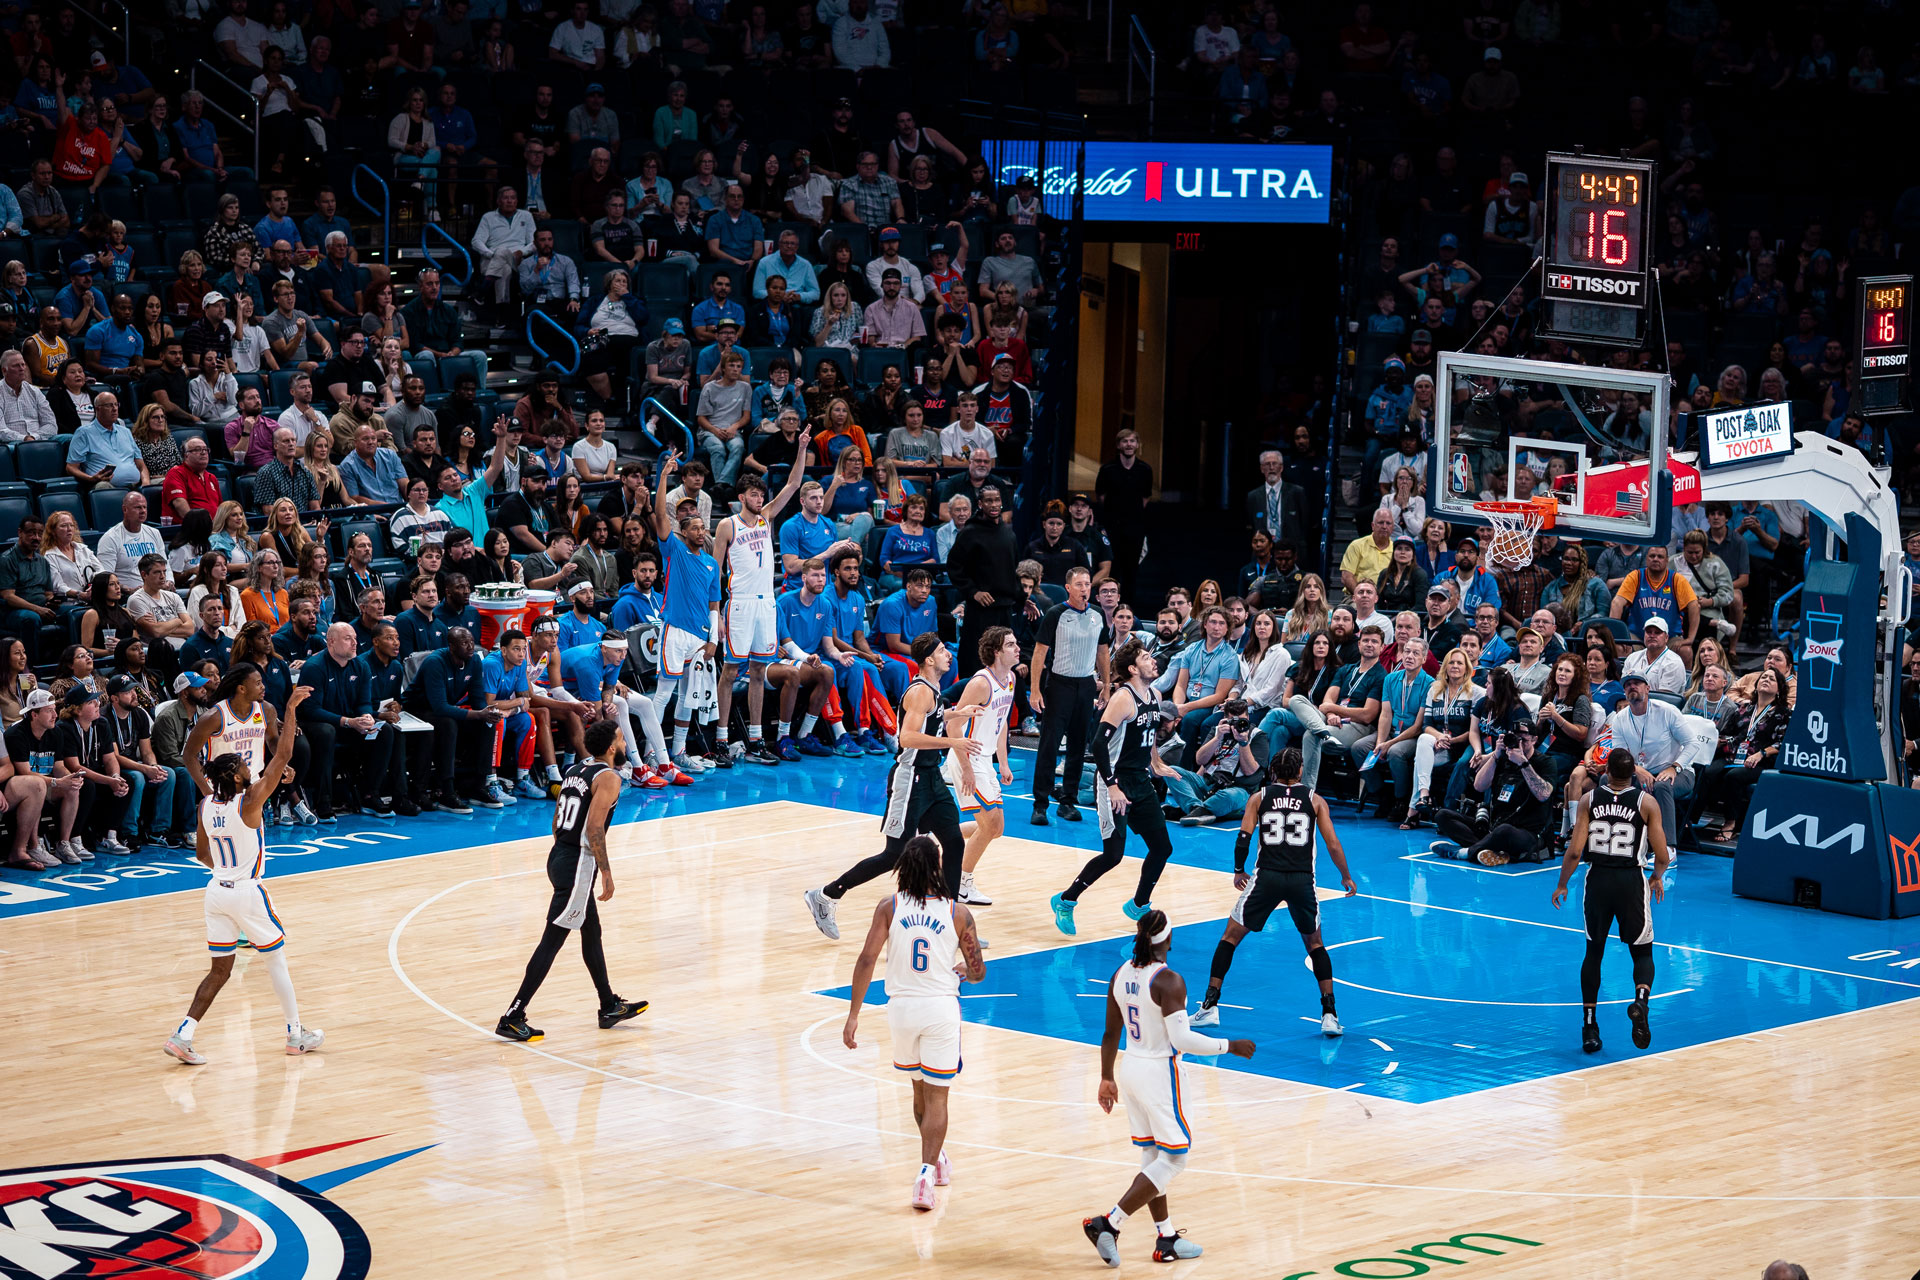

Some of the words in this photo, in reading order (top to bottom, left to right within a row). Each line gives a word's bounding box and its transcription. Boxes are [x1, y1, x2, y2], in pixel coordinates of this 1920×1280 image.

[1580, 173, 1638, 204] 4:47
[1176, 232, 1201, 250] EXIT
[1587, 210, 1628, 264] 16
[1571, 275, 1640, 296] TISSOT
[1876, 288, 1903, 308] 4:47
[1880, 313, 1895, 342] 16
[1875, 354, 1908, 368] TISSOT
[924, 399, 946, 408] OKC
[985, 407, 1011, 423] OKC
[1716, 415, 1742, 441] POST
[1759, 408, 1782, 434] OAK
[1726, 438, 1773, 459] TOYOTA
[123, 542, 155, 558] THUNDER
[749, 541, 765, 551] CITY
[755, 552, 763, 568] 7
[1638, 596, 1672, 611] THUNDER
[1807, 644, 1837, 656] SONIC
[997, 705, 1009, 717] CITY
[1432, 706, 1465, 716] THUDER
[223, 727, 265, 743] OKLAHOMA
[1140, 728, 1156, 747] 16
[235, 739, 253, 752] CITY
[1784, 743, 1847, 774] Health
[556, 794, 582, 831] 30
[1272, 797, 1303, 810] JONES
[212, 815, 226, 829] JOE
[1593, 804, 1636, 822] BRANHAM
[1260, 811, 1311, 847] 33
[1588, 820, 1635, 858] 22
[211, 835, 239, 869] 11
[900, 916, 946, 936] WILLIAMS
[911, 936, 931, 973] 6
[1125, 1003, 1142, 1042] 5
